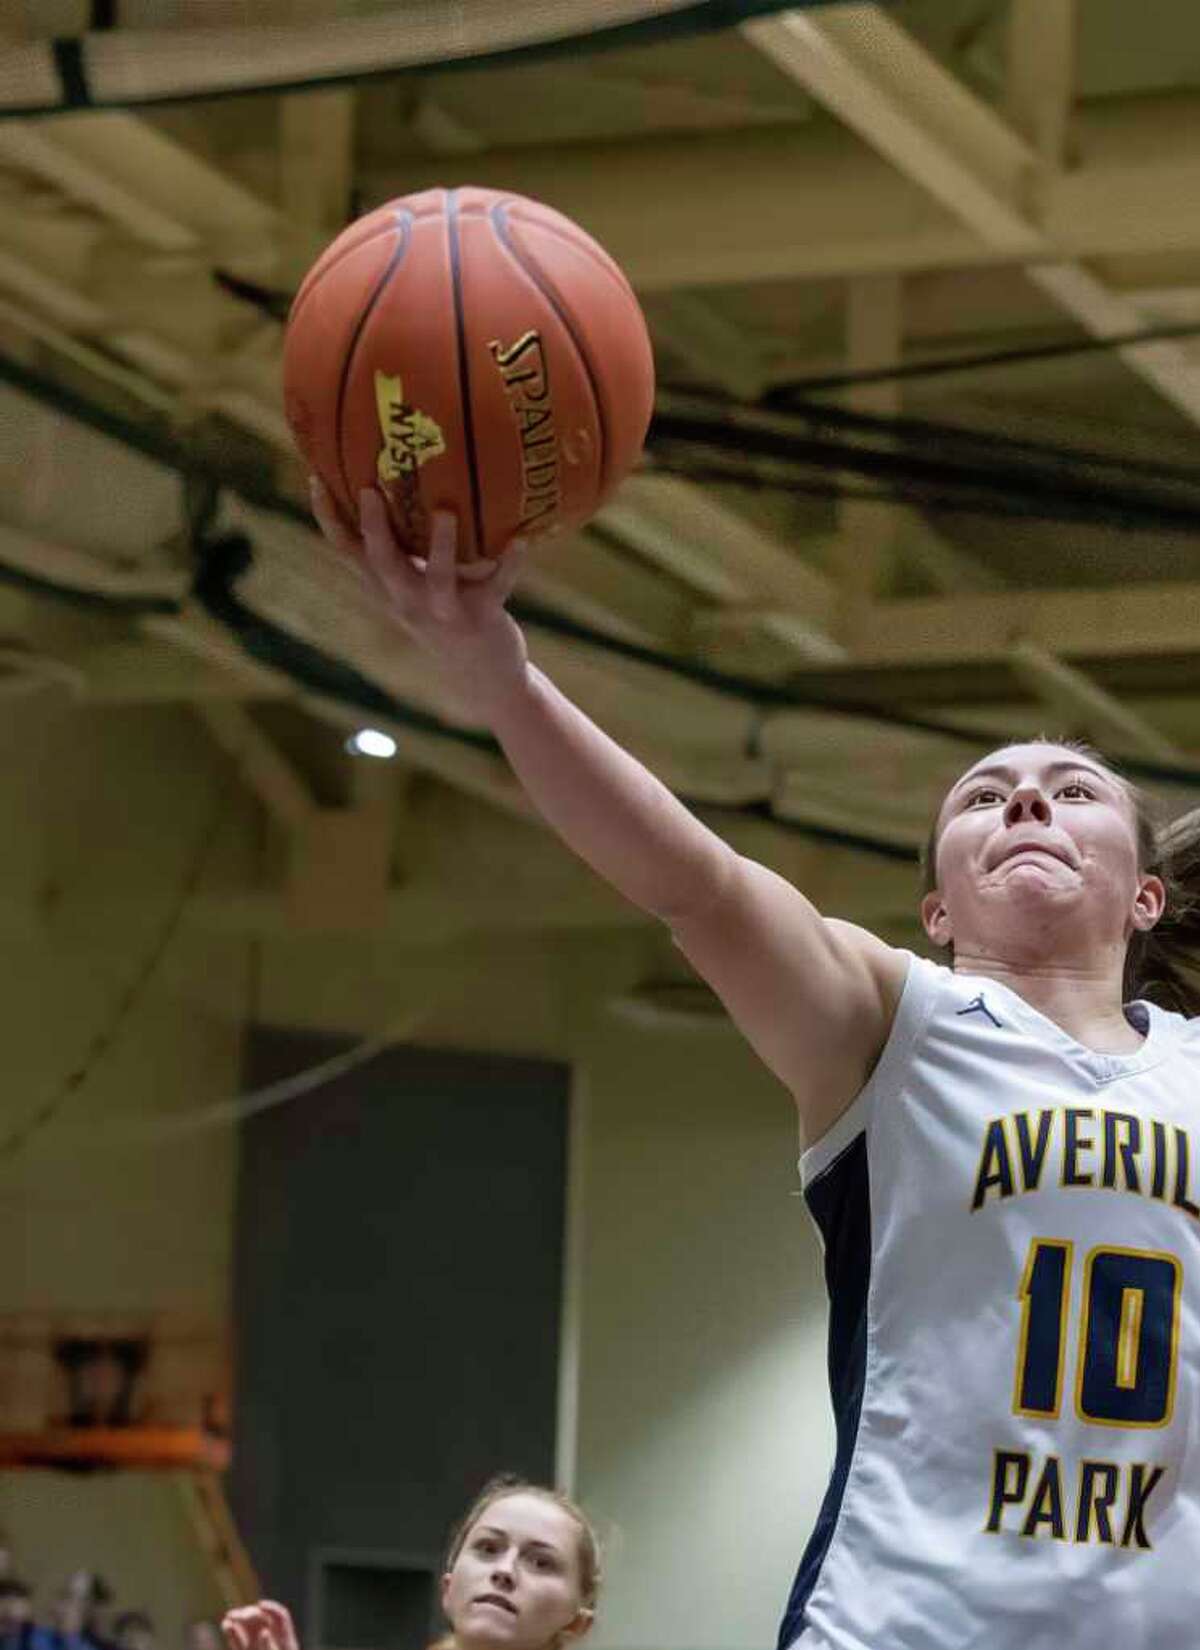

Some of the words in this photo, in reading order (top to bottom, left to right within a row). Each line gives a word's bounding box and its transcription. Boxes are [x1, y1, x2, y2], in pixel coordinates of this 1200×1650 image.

[487, 328, 560, 536] SPALDIN
[1013, 1239, 1184, 1429] 10
[984, 1449, 1166, 1550] PARK
